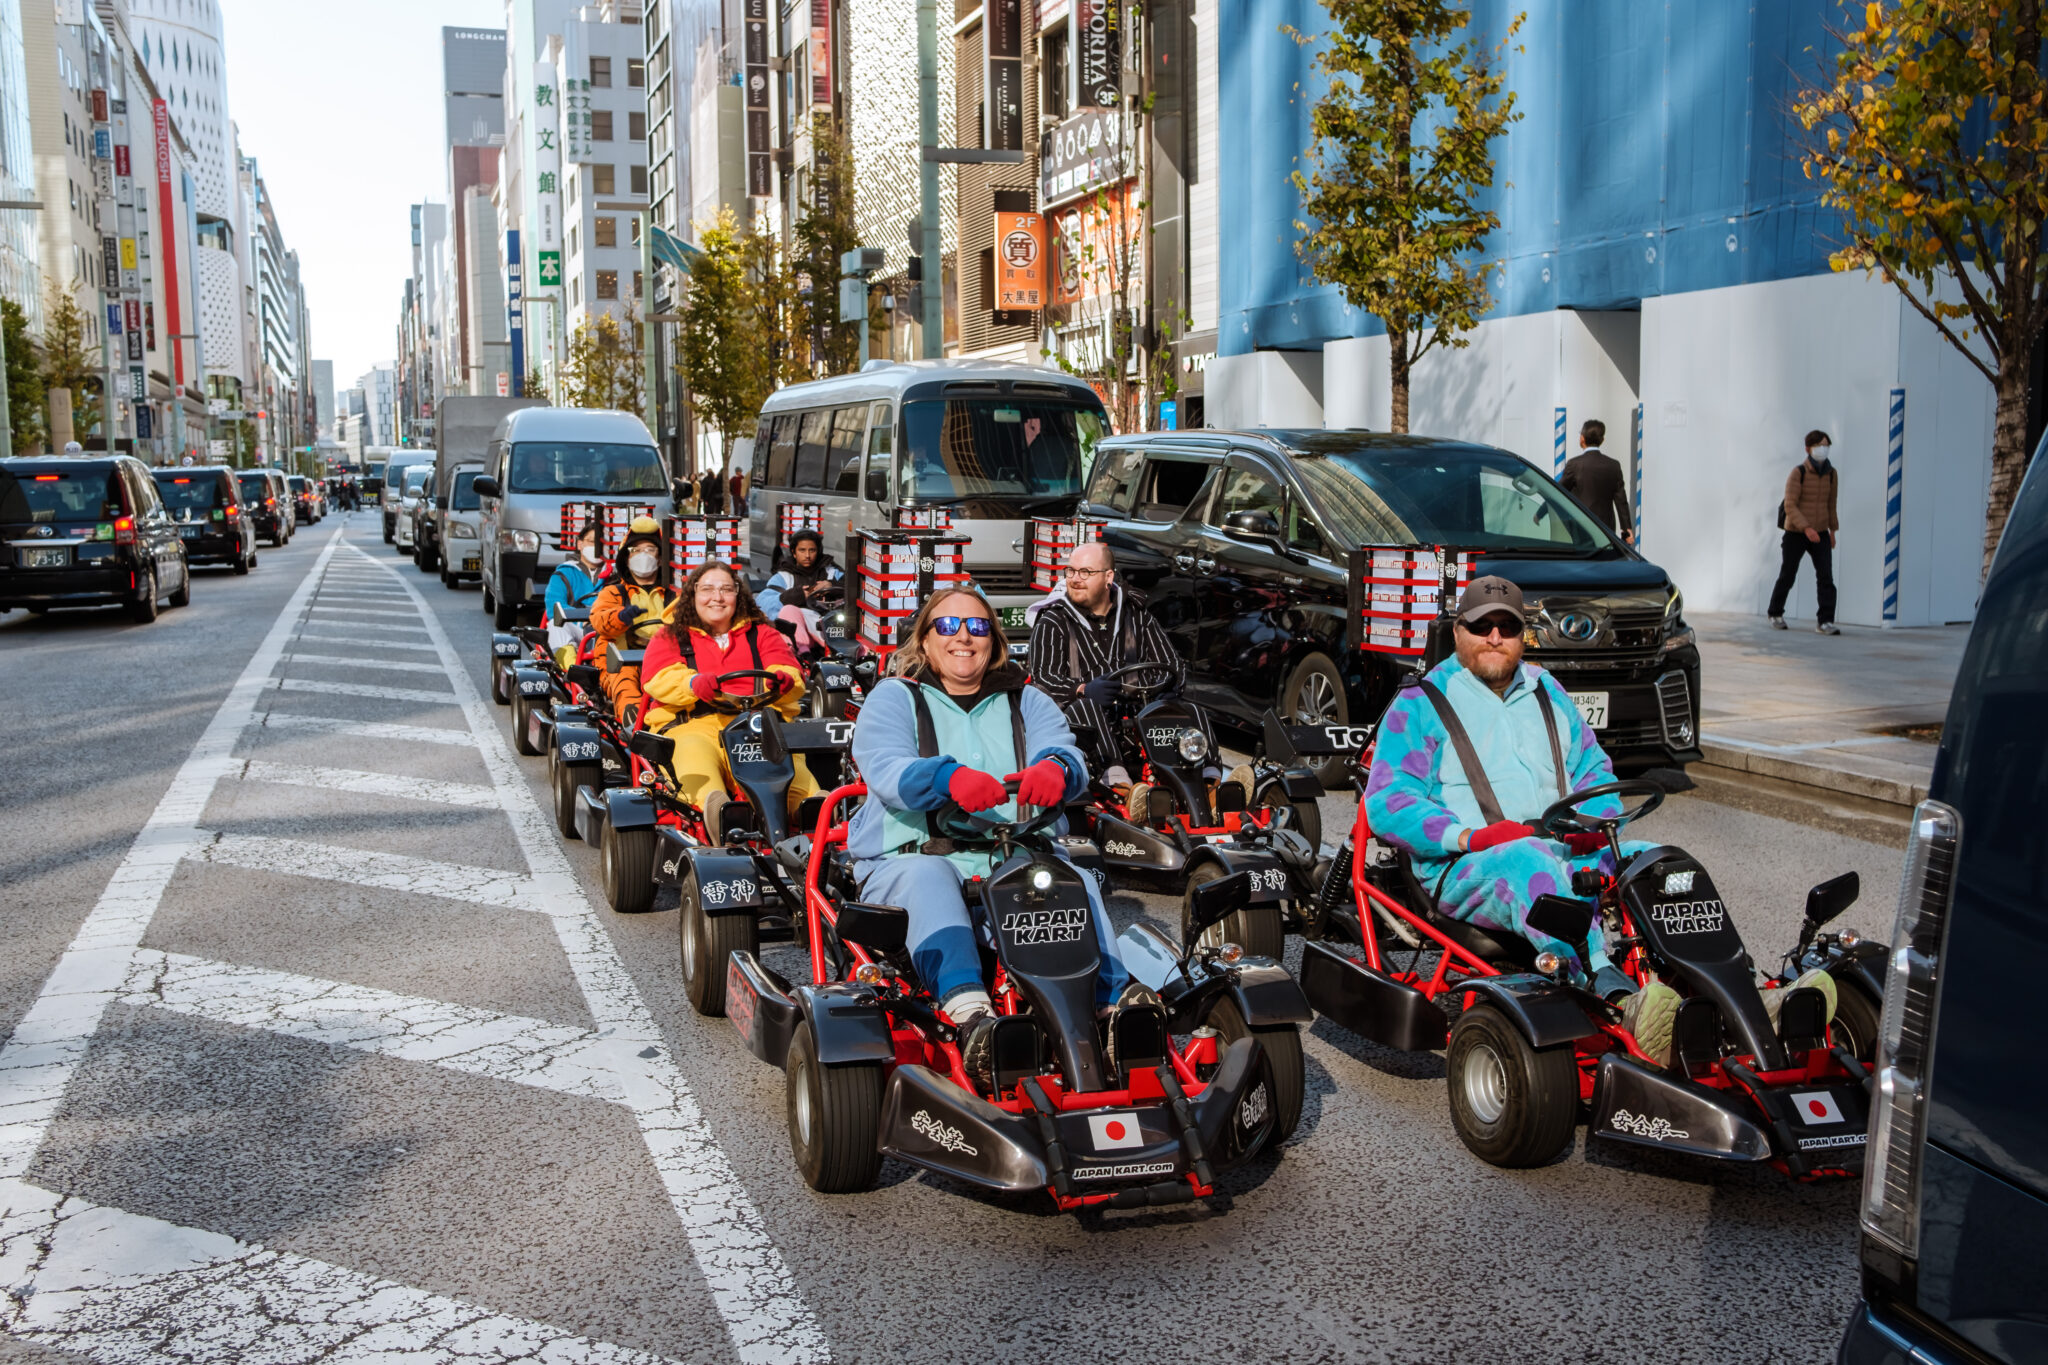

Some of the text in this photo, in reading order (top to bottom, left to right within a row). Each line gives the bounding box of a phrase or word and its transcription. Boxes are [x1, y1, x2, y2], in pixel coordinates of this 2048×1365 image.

[455, 32, 505, 41] LONGCHAM
[1090, 0, 1107, 86] DORIYA
[155, 104, 170, 183] MITSUKOSHI
[535, 84, 555, 194] 教文館
[1015, 216, 1037, 228] 2F
[1007, 236, 1033, 263] 質
[541, 256, 559, 280] 本
[1002, 290, 1039, 305] 大黒屋
[562, 742, 600, 758] 雷神
[731, 743, 763, 754] JAP
[702, 879, 755, 904] 雷神
[1002, 908, 1087, 931] JAPAN
[1651, 900, 1723, 920] JAPAN
[1014, 924, 1085, 945] KART
[1664, 915, 1723, 935] KART
[911, 1109, 978, 1156] 安全第一
[1611, 1108, 1690, 1141] 安全第一
[1073, 1161, 1174, 1180] JAPAN KART.com
